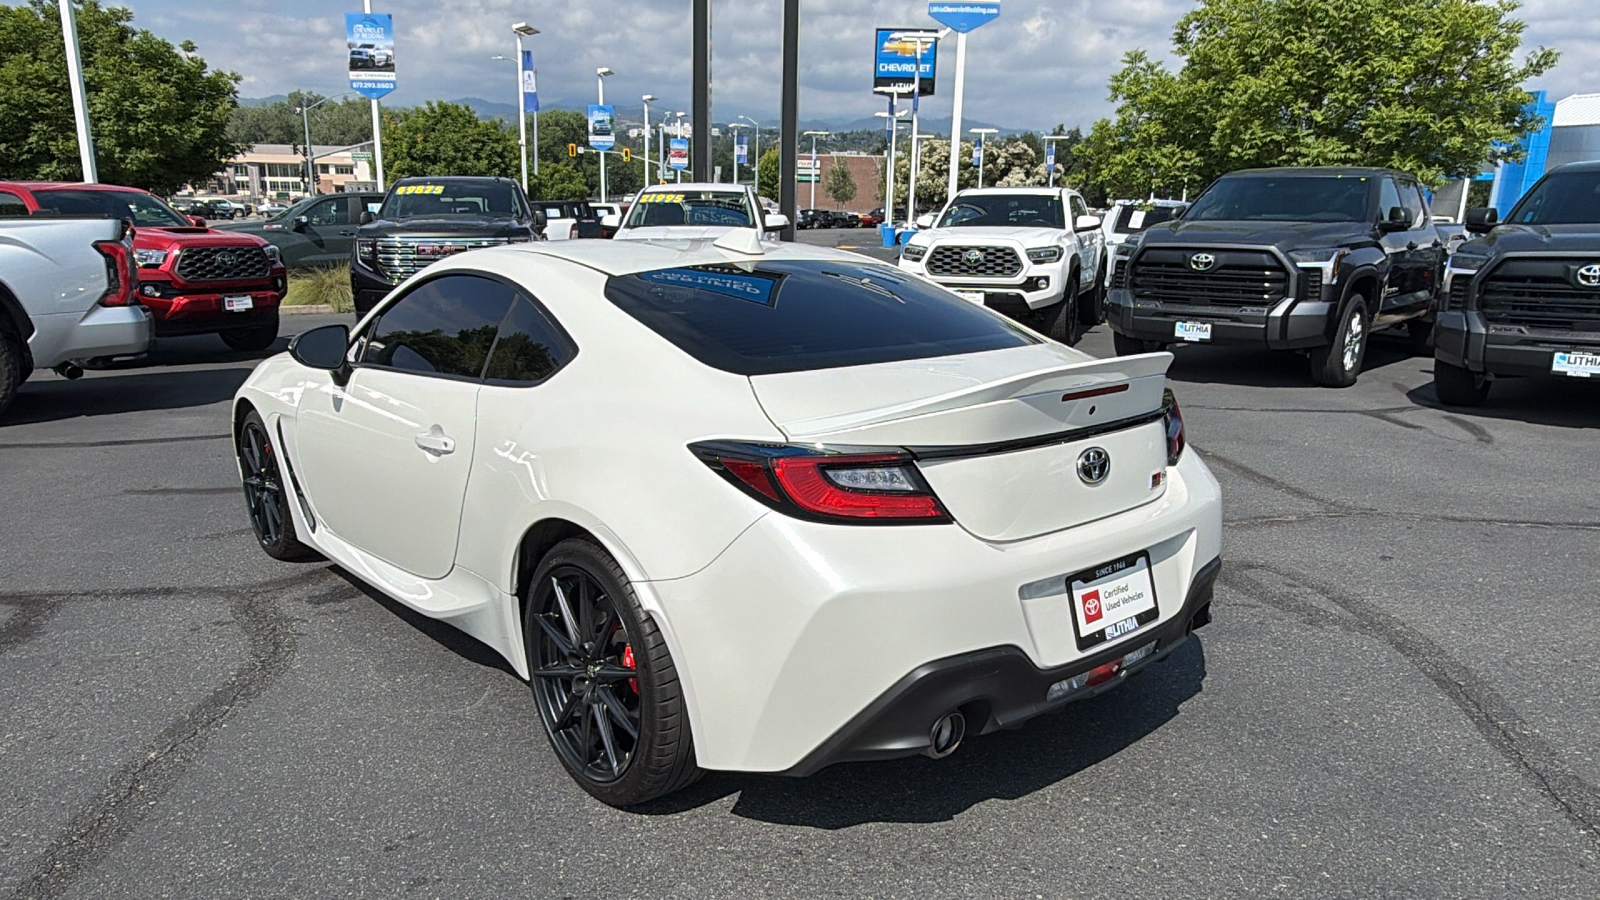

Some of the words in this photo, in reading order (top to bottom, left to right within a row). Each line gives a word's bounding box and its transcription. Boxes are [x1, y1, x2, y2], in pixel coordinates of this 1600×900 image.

[930, 5, 998, 15] LithiaChevroletRedding.com
[353, 26, 384, 34] CHEVROLET
[879, 63, 931, 72] CHEVROET
[639, 194, 685, 203] 21995
[1184, 324, 1209, 333] LITHIA
[1095, 565, 1112, 577] SINCE
[1103, 583, 1129, 599] Certified
[1105, 599, 1121, 611] Used
[1120, 591, 1144, 606] Vehicles
[1112, 616, 1139, 636] LITHIA
